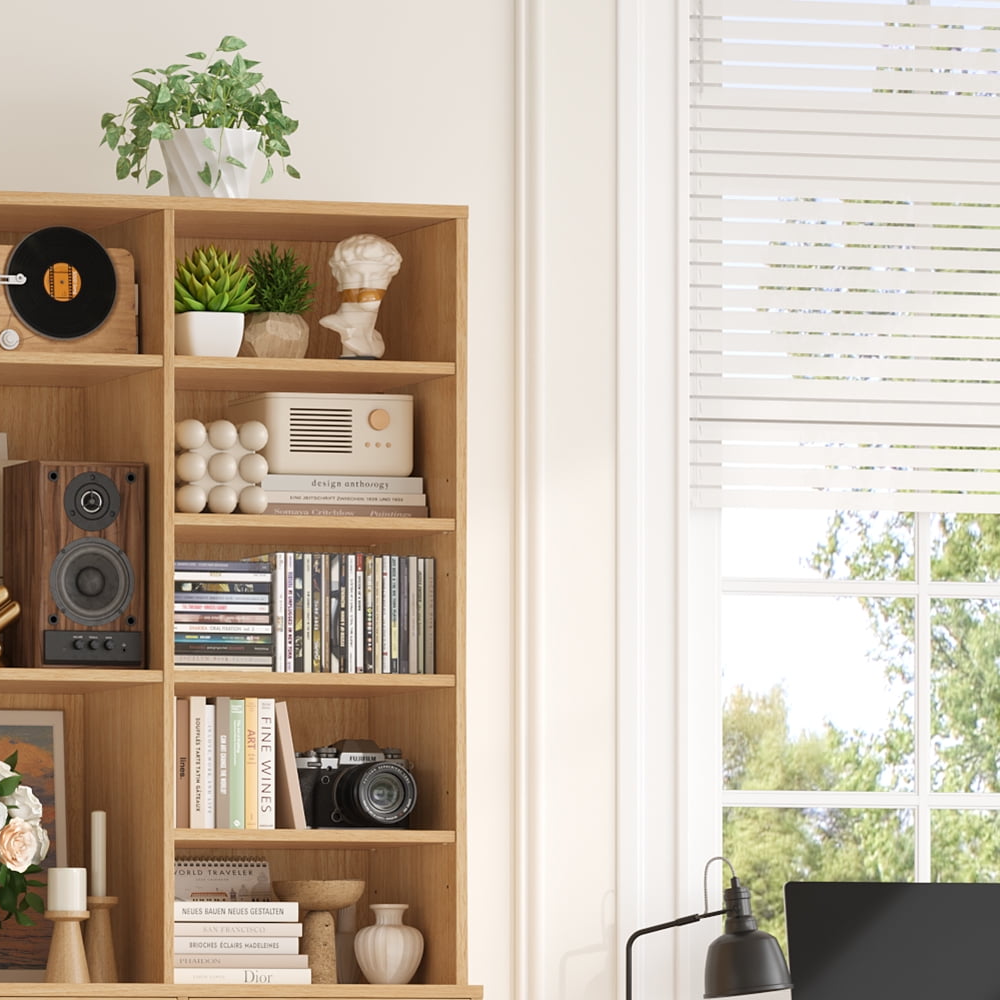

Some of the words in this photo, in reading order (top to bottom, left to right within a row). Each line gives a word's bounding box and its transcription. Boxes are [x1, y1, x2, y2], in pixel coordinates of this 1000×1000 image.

[311, 479, 342, 489] design
[247, 729, 256, 750] ART
[260, 717, 272, 753] FINE
[260, 760, 272, 813] WINES
[244, 970, 273, 983] Dior
